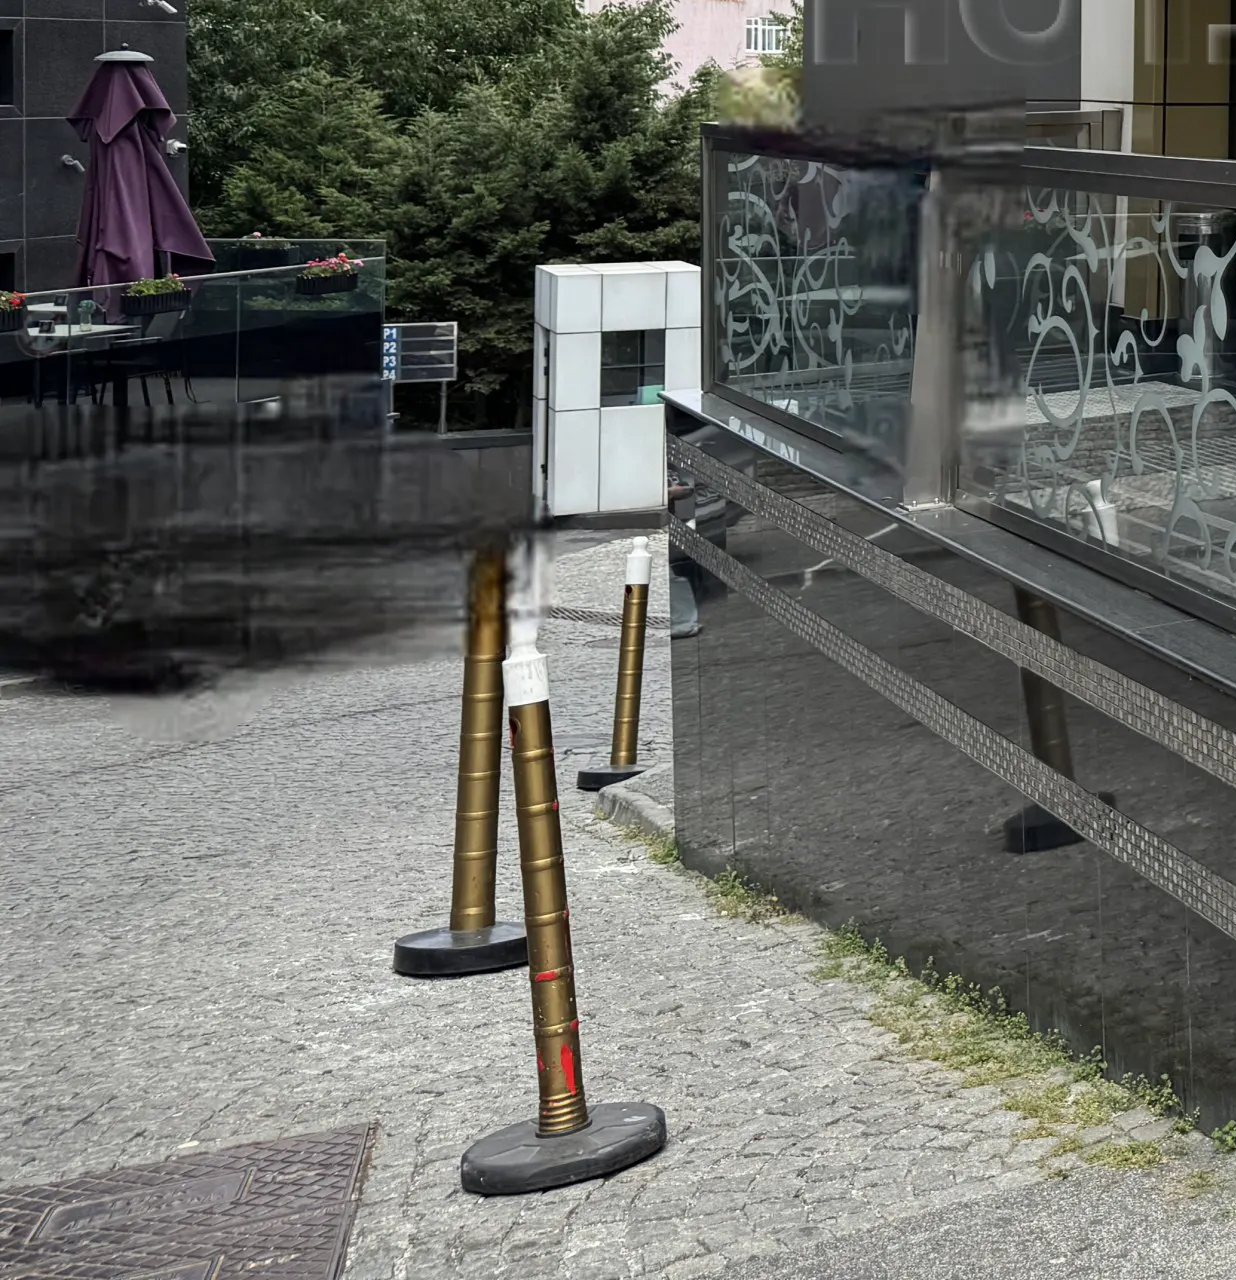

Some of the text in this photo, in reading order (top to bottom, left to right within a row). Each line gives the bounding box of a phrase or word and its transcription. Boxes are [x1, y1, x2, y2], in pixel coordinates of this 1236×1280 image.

[383, 328, 396, 339] P1
[383, 342, 396, 353] P2
[383, 356, 396, 367] P3
[383, 370, 396, 380] P4
